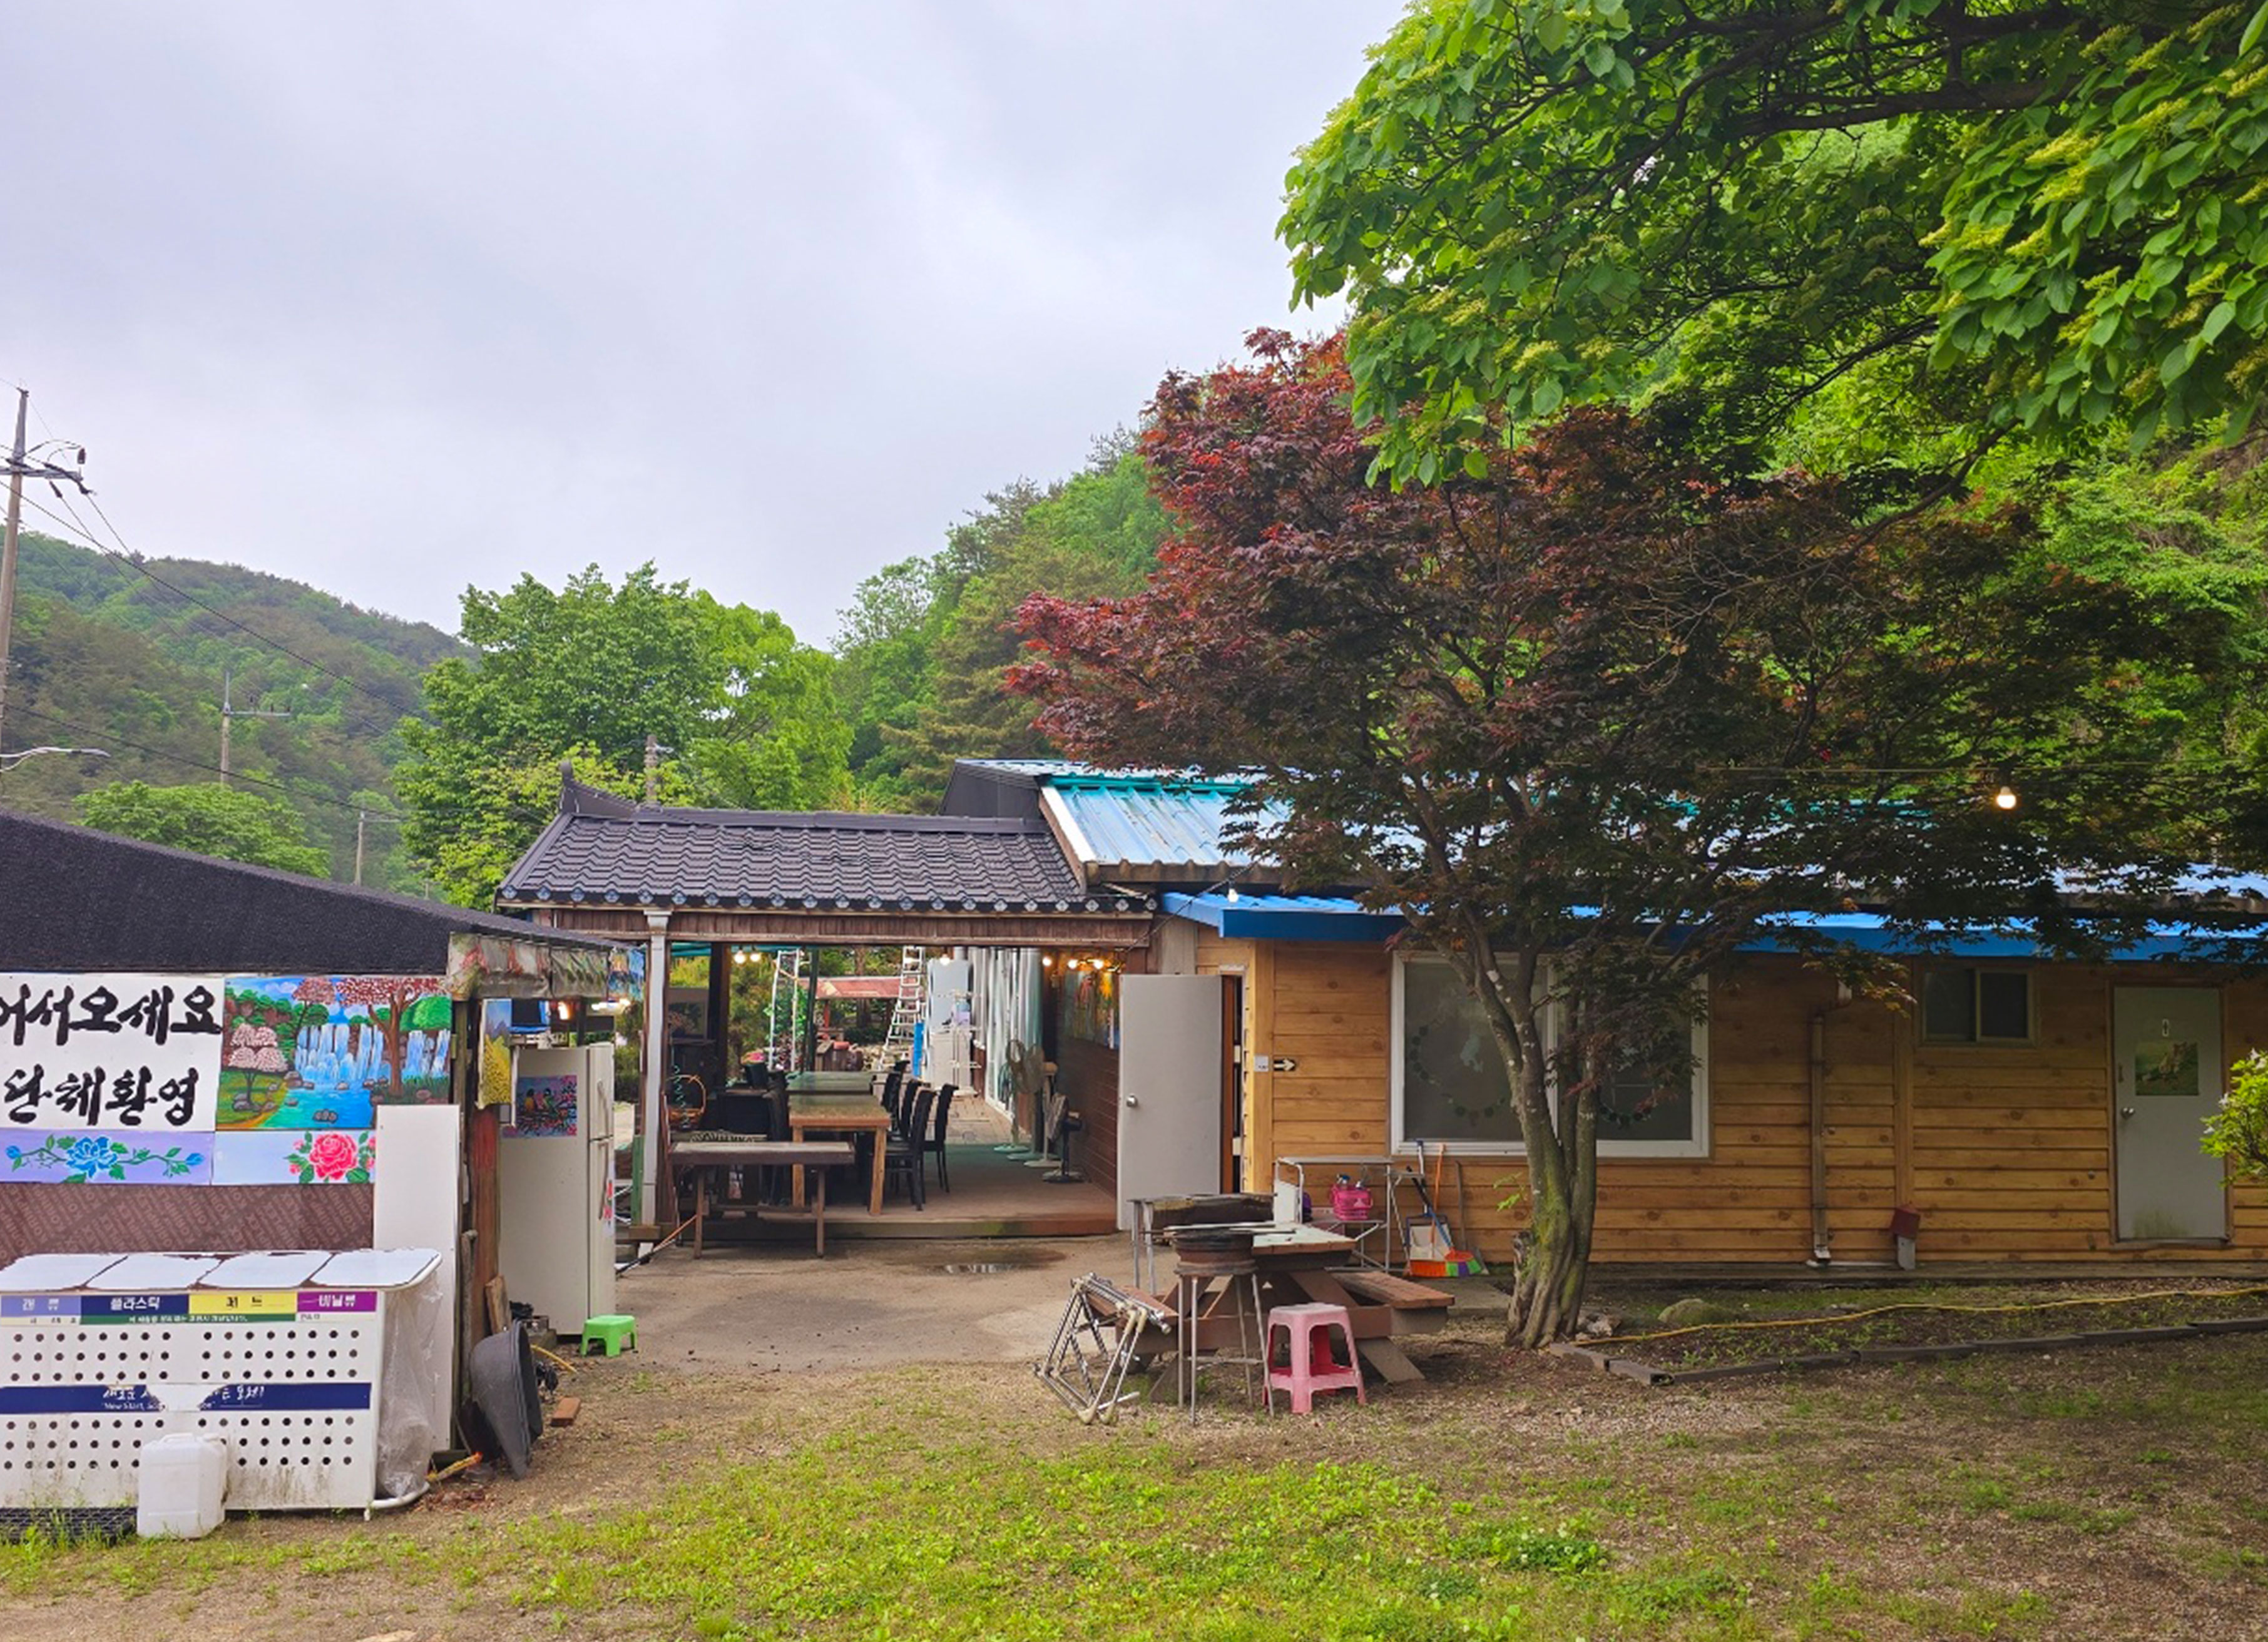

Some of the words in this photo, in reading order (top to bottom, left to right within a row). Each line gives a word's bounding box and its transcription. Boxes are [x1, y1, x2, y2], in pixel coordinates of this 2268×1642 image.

[0, 984, 222, 1046] 어서오세요
[4, 1064, 198, 1126] 단체환영
[110, 1297, 160, 1311] 플라스틱
